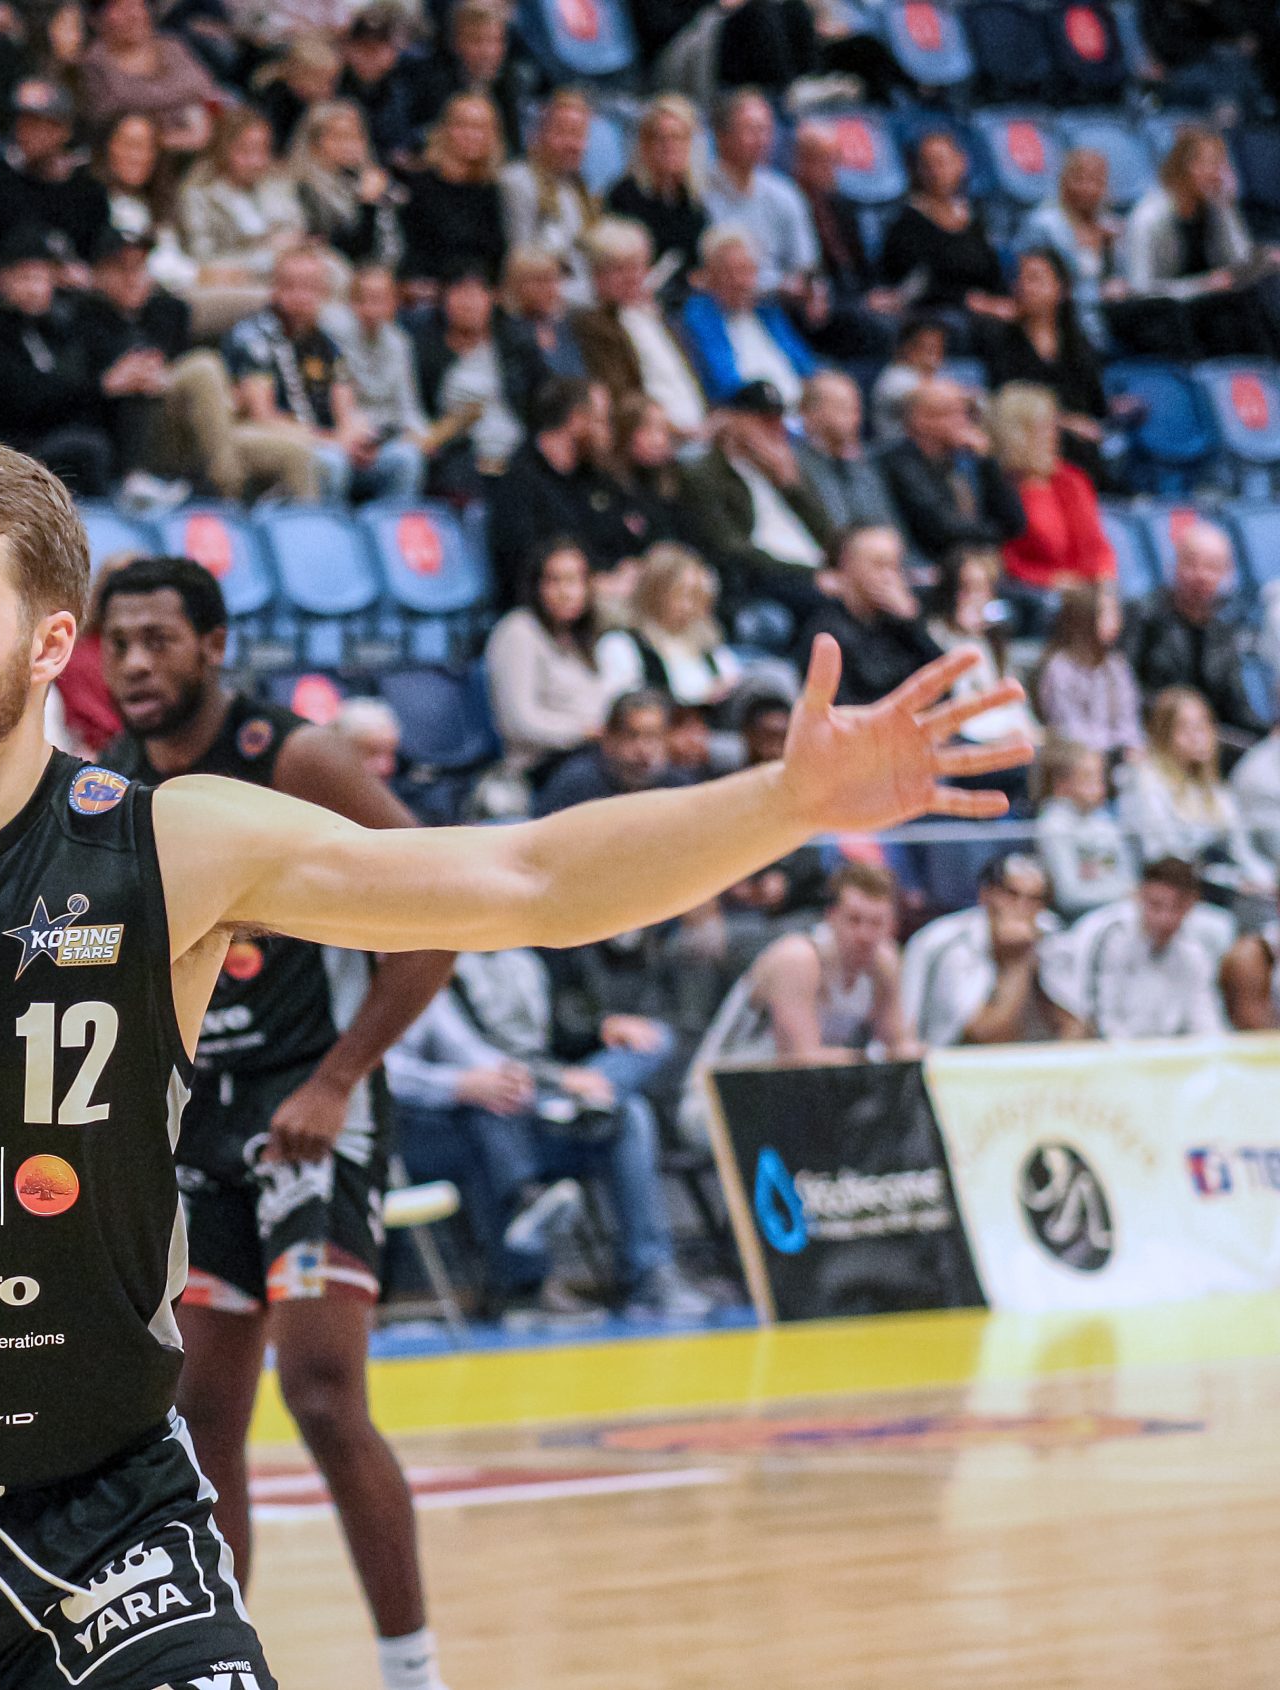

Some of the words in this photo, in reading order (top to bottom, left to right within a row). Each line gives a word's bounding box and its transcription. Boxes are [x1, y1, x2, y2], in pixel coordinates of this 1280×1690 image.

[31, 927, 120, 949] KÖPING
[61, 945, 114, 960] STARS
[16, 1000, 119, 1126] 12
[74, 1582, 192, 1654] YARA
[210, 1660, 252, 1673] KÖPING
